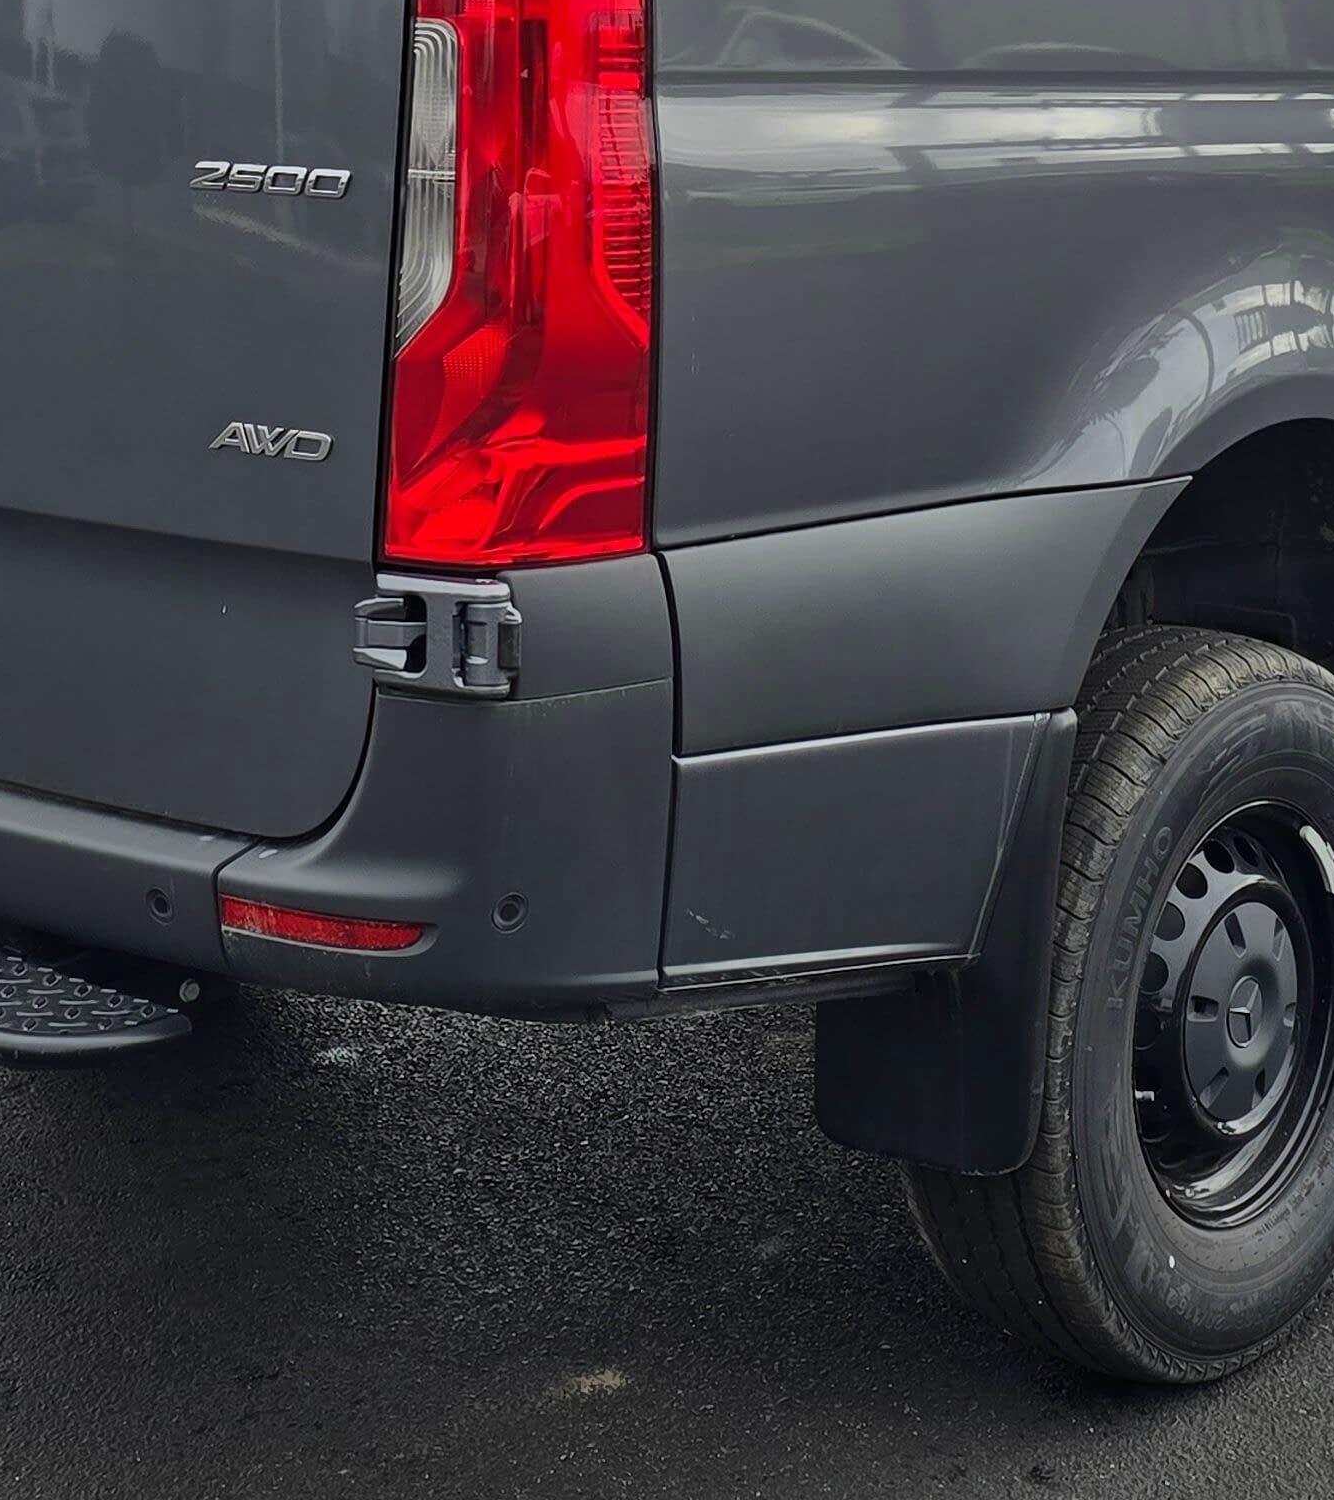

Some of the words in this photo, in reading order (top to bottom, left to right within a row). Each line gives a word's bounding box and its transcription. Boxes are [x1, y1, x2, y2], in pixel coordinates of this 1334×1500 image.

[190, 161, 351, 198] 2500
[209, 422, 332, 461] AWD
[1107, 827, 1172, 1010] KUMHO
